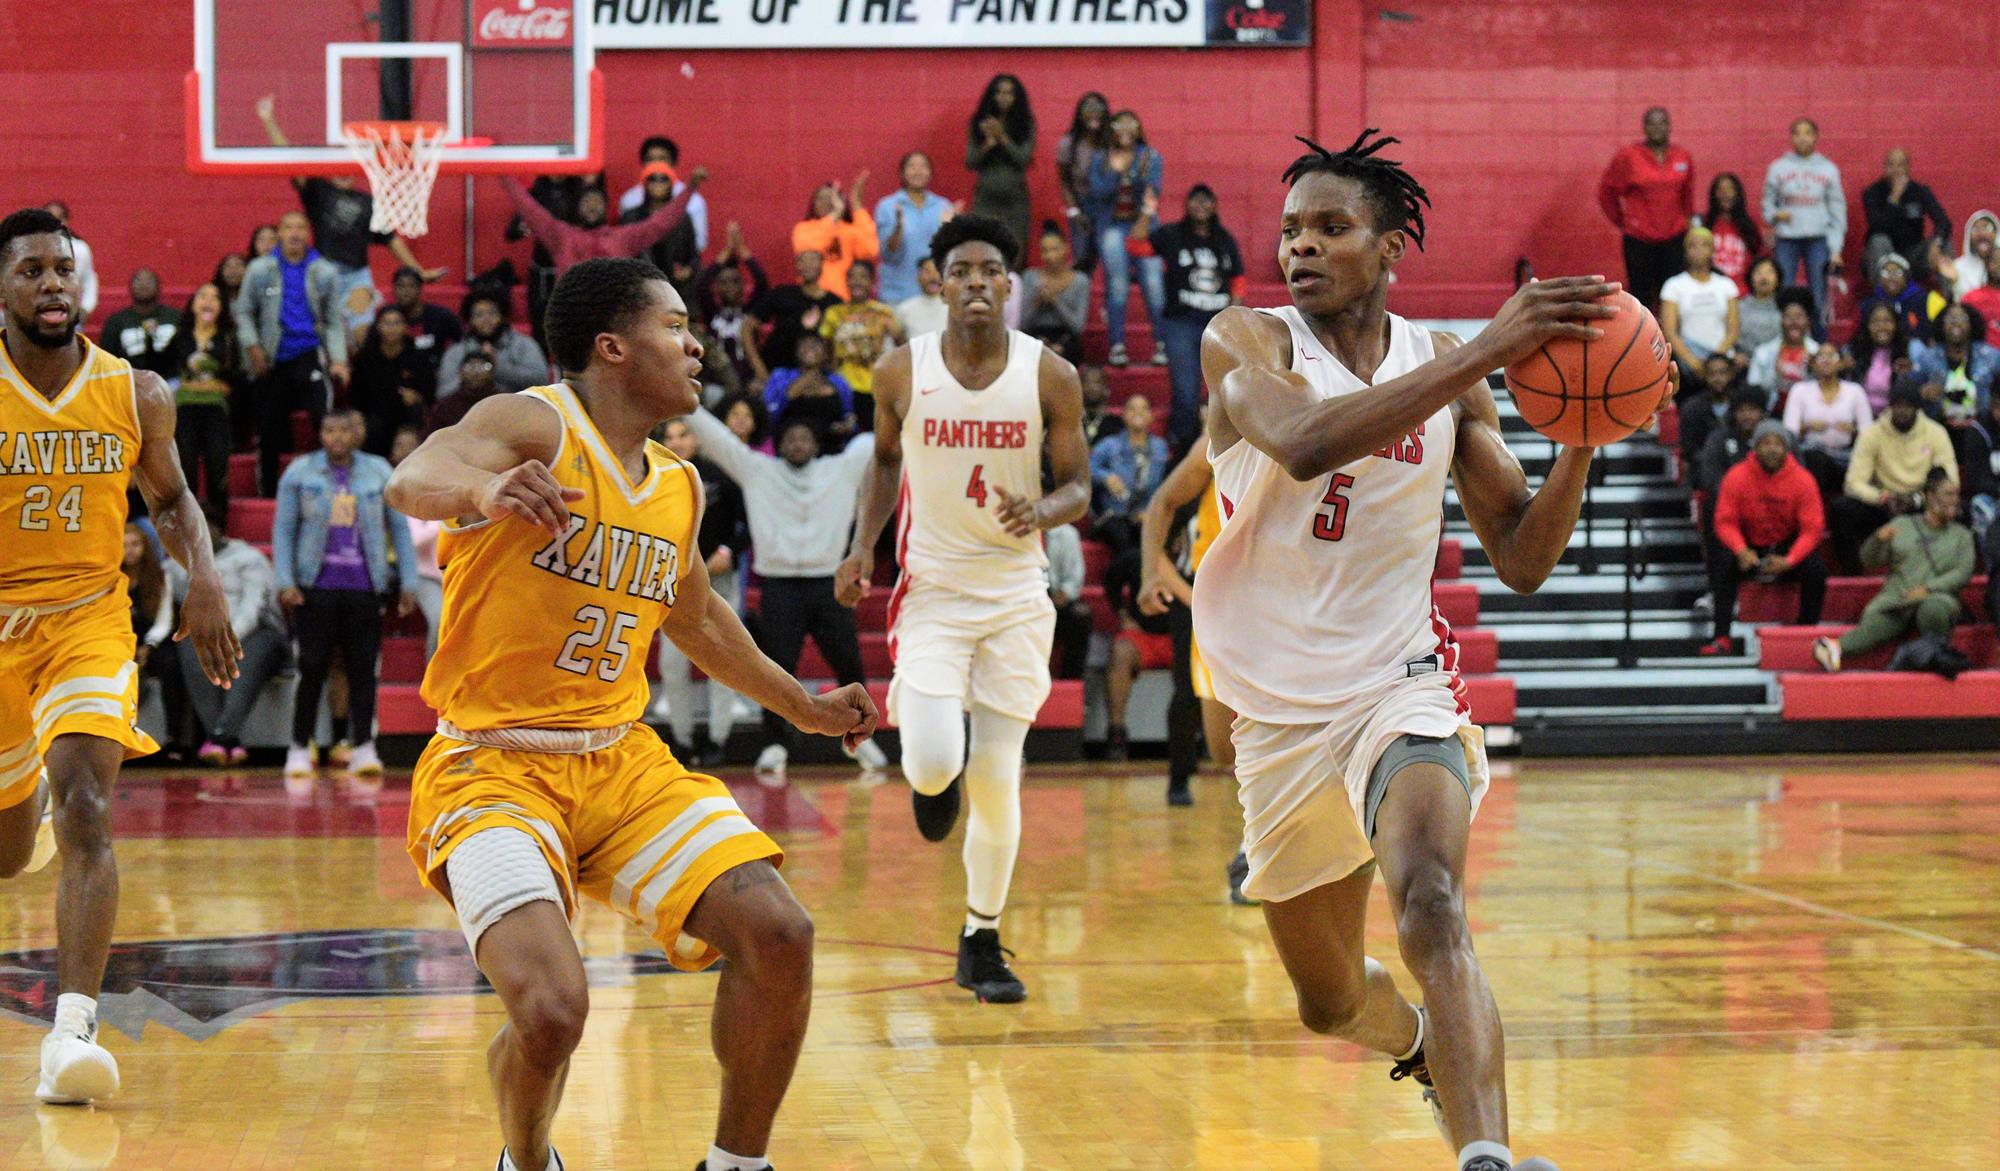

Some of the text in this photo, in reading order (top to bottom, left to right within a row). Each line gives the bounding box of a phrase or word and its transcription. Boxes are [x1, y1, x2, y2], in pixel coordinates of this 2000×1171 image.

[479, 7, 569, 39] Coca-Cola
[593, 0, 719, 24] HOME
[0, 431, 123, 475] AVIER
[924, 418, 1027, 449] PANTHERS
[20, 484, 83, 532] 24
[966, 464, 988, 508] 4
[1312, 472, 1355, 542] 5
[531, 512, 678, 608] XAVIER
[554, 604, 638, 682] 25
